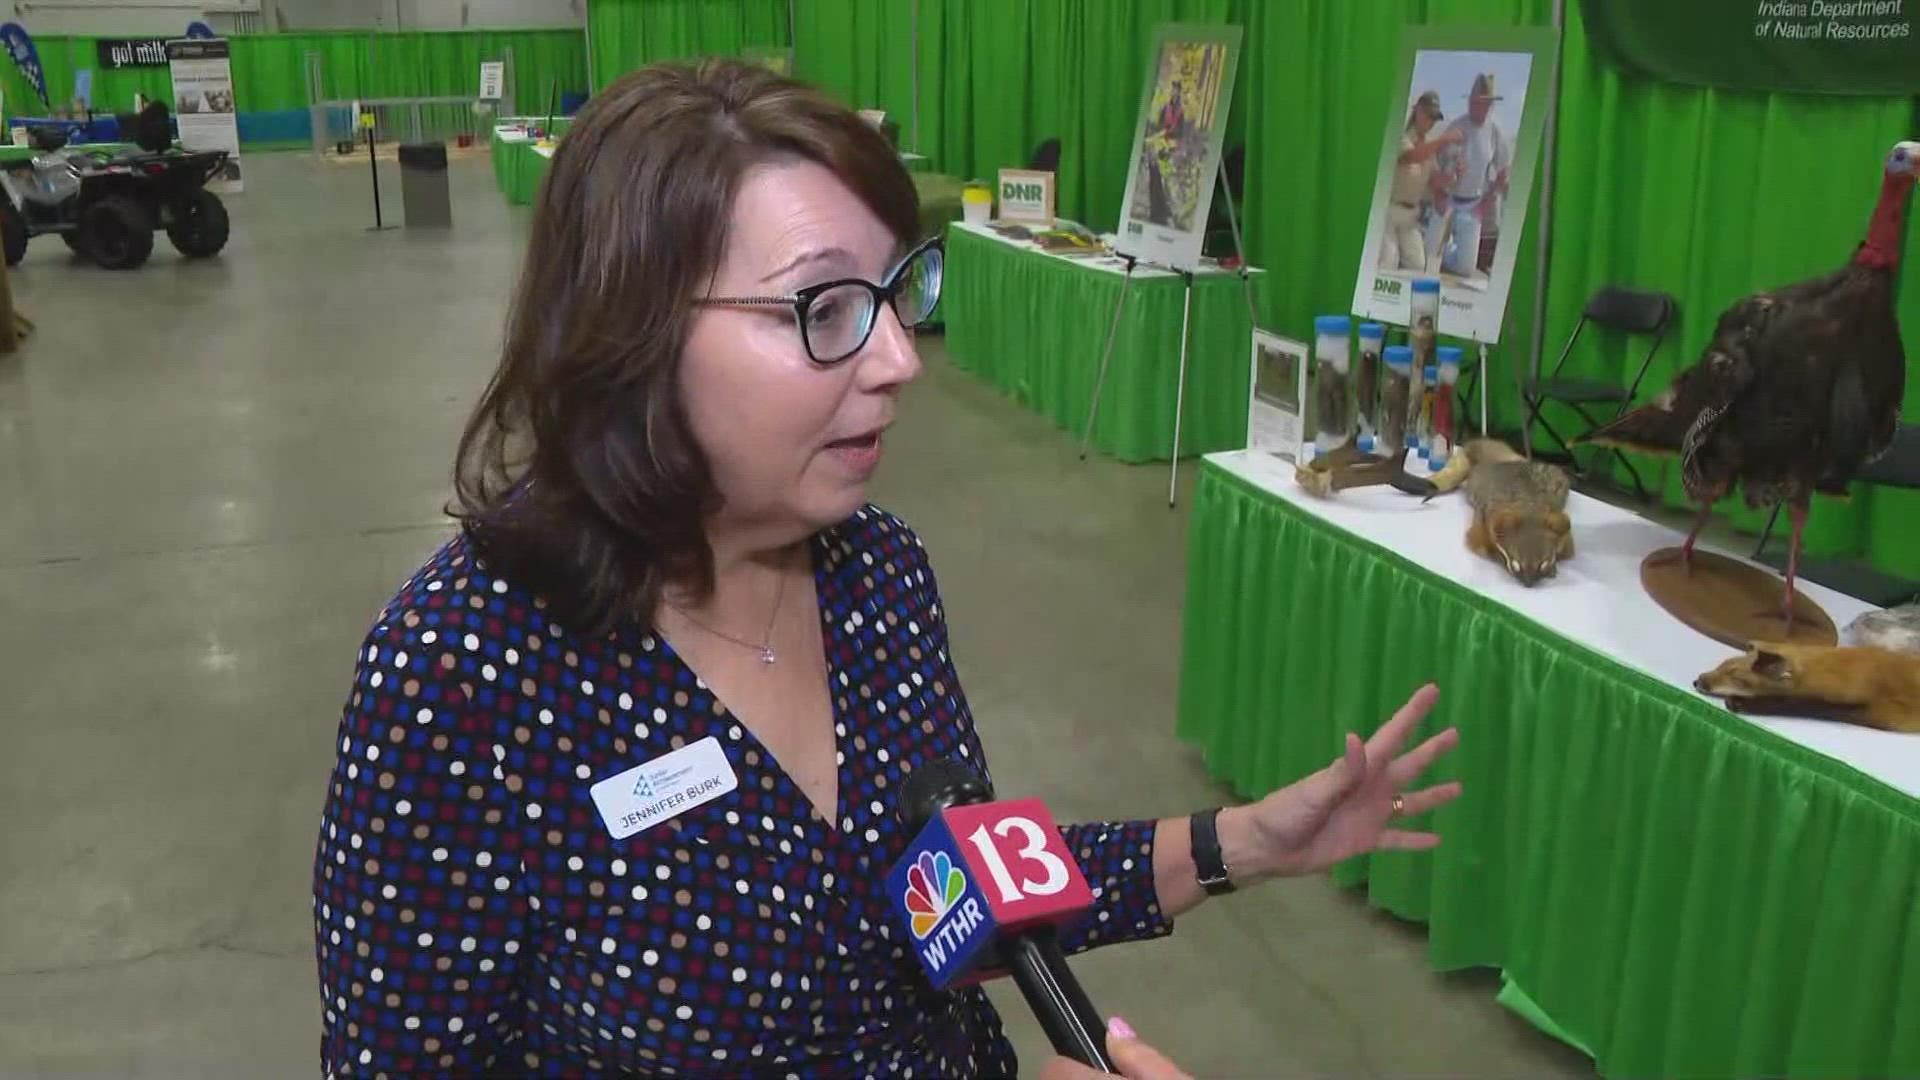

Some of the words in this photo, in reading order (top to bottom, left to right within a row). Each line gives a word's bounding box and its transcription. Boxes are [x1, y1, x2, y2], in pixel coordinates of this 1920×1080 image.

[1758, 0, 1807, 16] Indiana
[1811, 0, 1902, 18] Department
[1755, 21, 1771, 37] of
[1773, 21, 1823, 39] Natural
[1825, 22, 1910, 39] Resources
[112, 41, 134, 67] got
[1002, 182, 1042, 202] DNR
[1373, 278, 1402, 296] DNR
[619, 792, 686, 829] JENNIFER
[686, 775, 723, 800] BURK
[967, 816, 1069, 904] 13
[922, 897, 984, 972] WTHR
